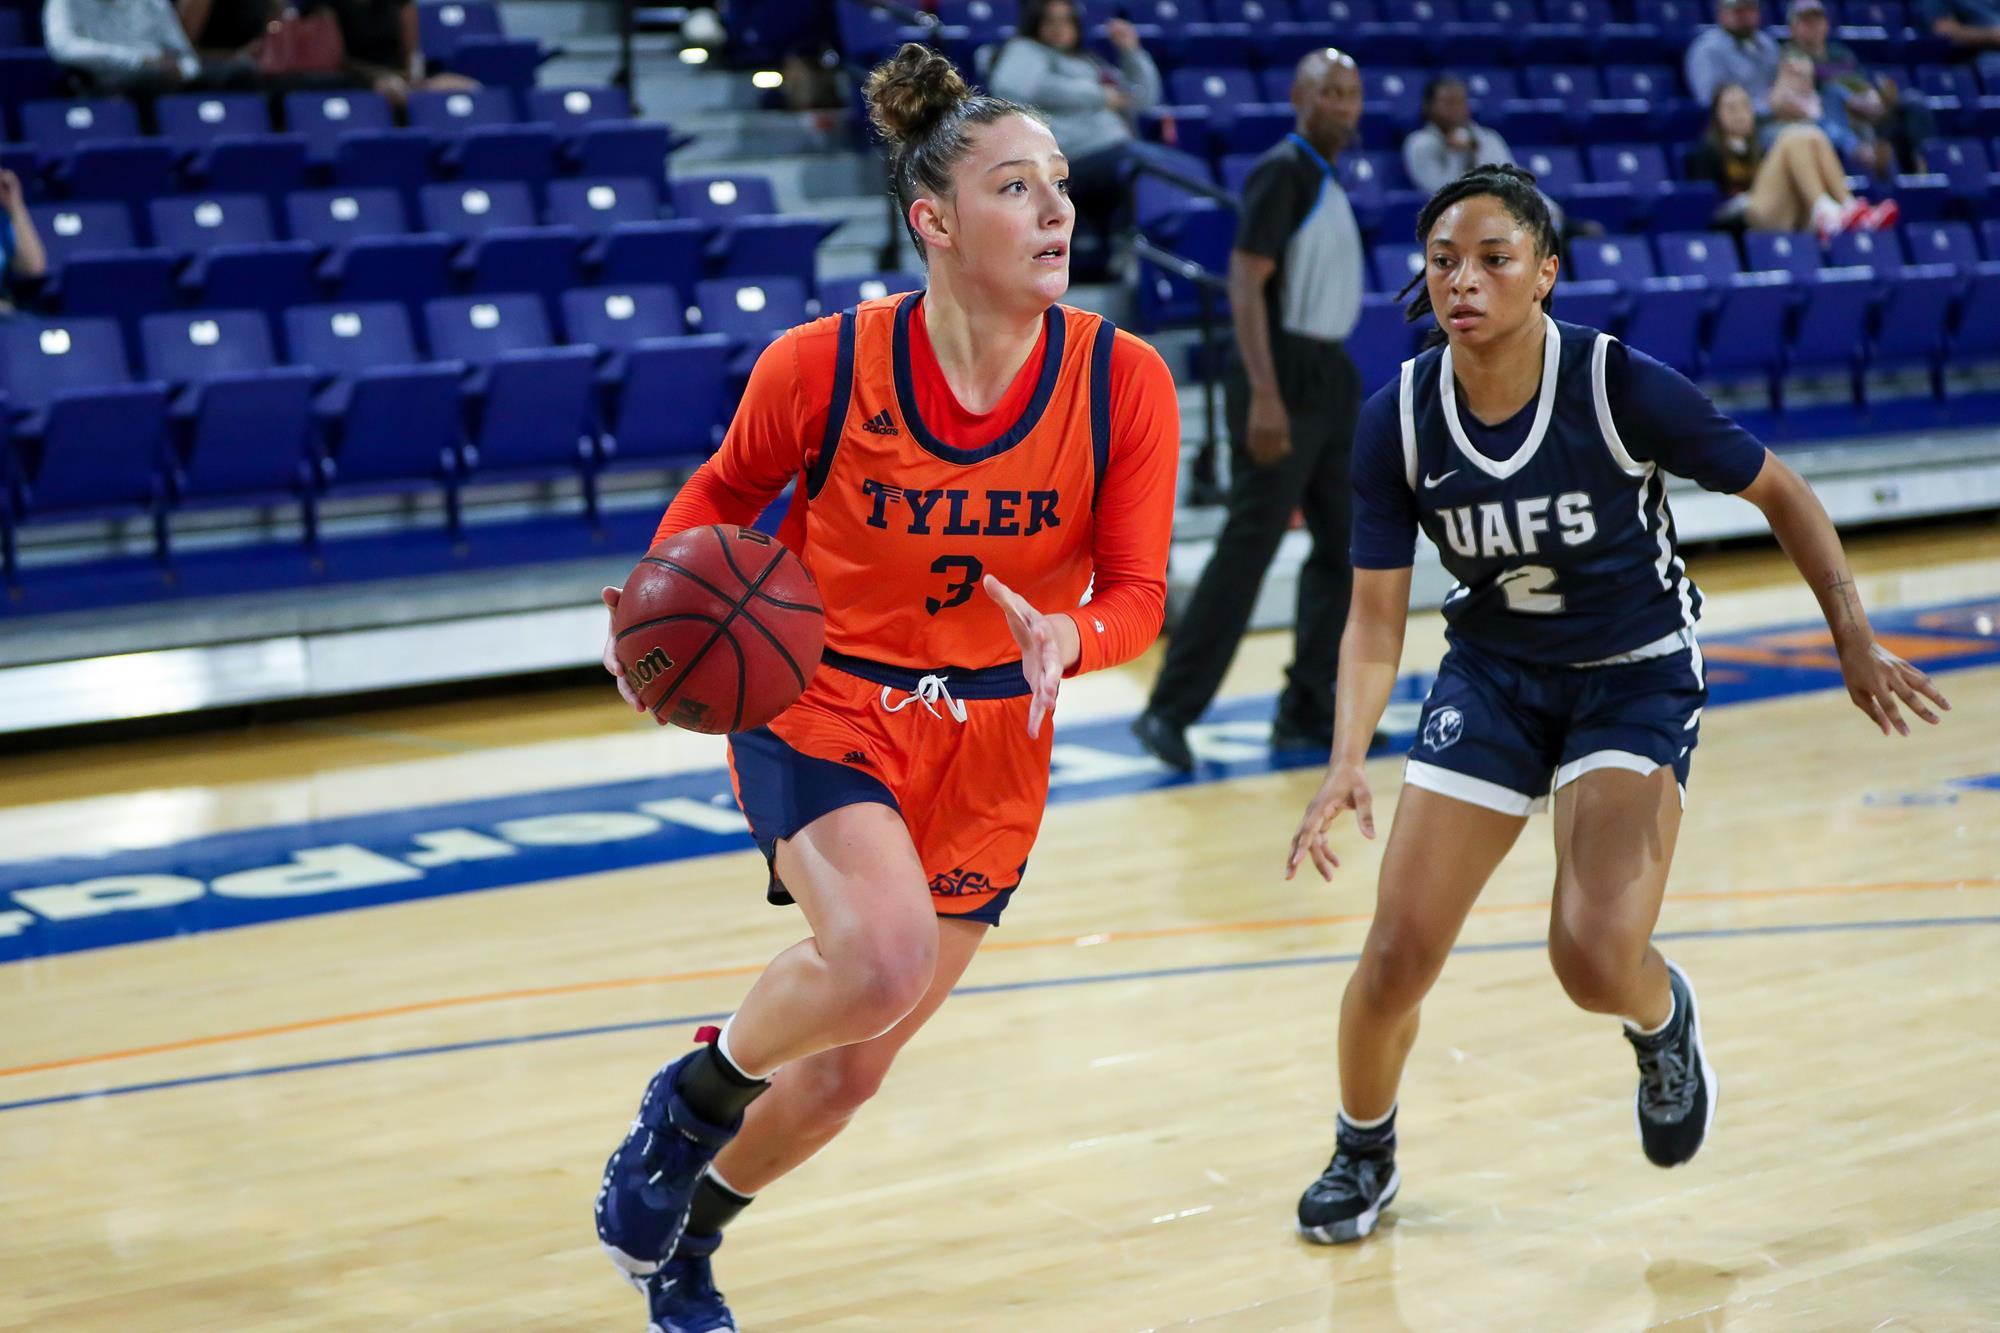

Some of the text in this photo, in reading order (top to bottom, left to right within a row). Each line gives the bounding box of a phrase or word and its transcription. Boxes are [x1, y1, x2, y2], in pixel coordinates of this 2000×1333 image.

[862, 421, 899, 437] adidas
[862, 477, 1061, 537] TYLER
[1435, 491, 1598, 557] UAFS
[925, 554, 984, 617] 3
[1494, 564, 1566, 615] 2
